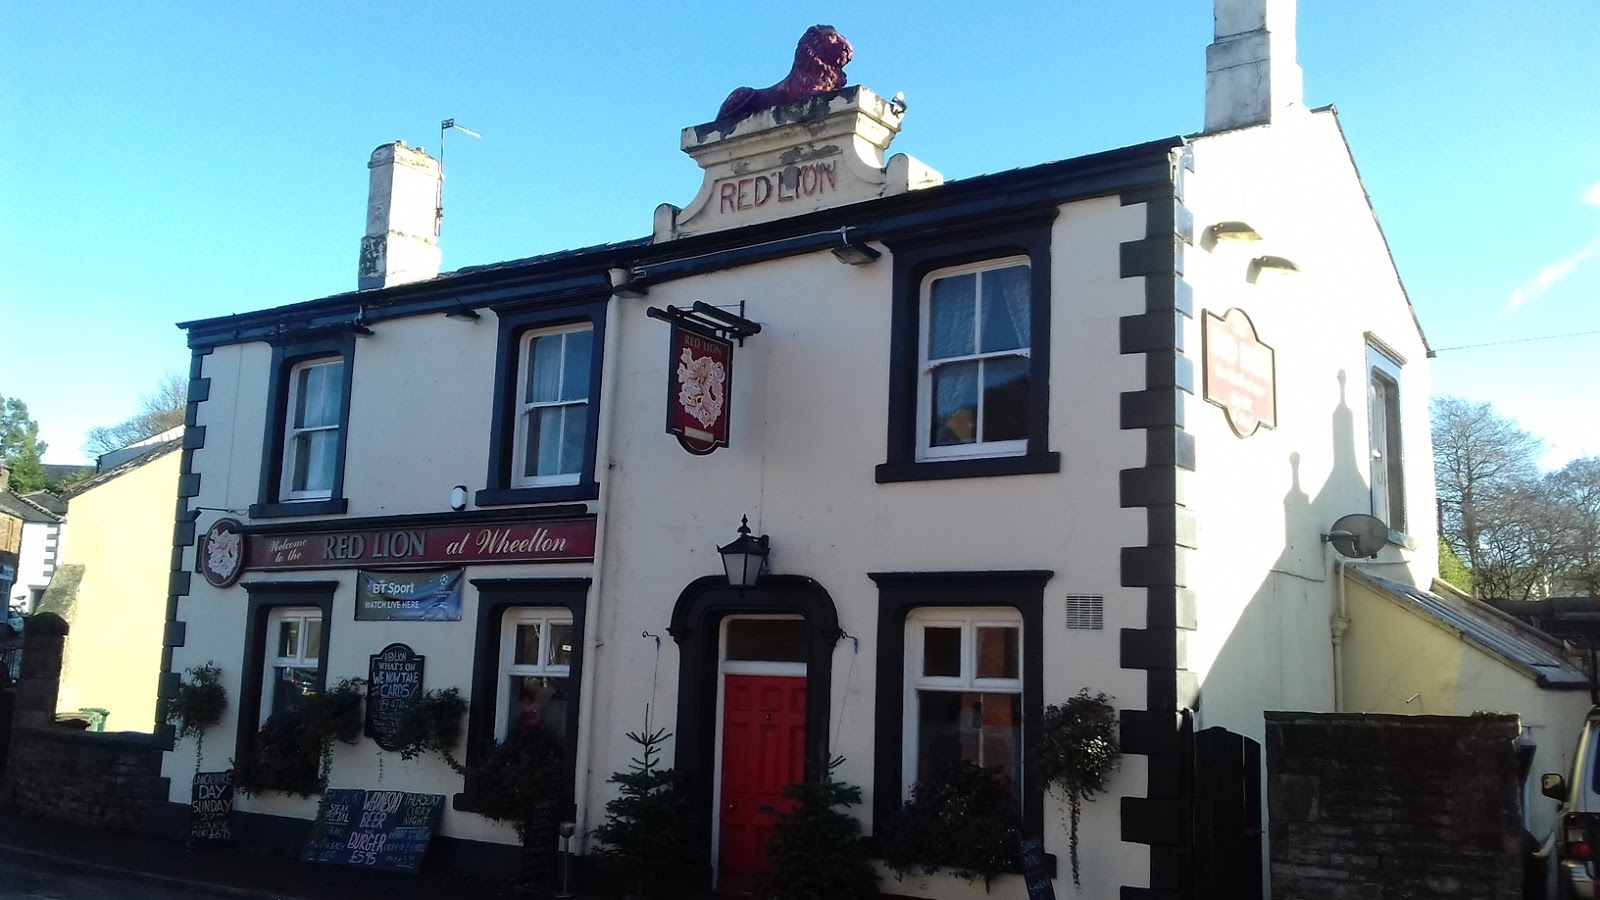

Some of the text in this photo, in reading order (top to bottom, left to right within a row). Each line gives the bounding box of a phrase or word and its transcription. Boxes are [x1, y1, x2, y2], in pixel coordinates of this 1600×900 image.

[720, 160, 838, 214] RED LION
[684, 335, 722, 356] RED LION
[269, 538, 308, 553] Welcome
[322, 531, 427, 560] RED LION
[446, 527, 567, 555] at Wheelton
[274, 549, 302, 563] to the
[372, 582, 415, 595] BT Sport
[365, 600, 420, 609] WATCH LIVE HERE
[378, 662, 416, 671] WHAT'S ON
[372, 671, 419, 684] WE NOW TAKE
[380, 683, 410, 698] CARDS
[198, 784, 227, 799] DAY
[192, 799, 232, 813] SUNDAY
[404, 793, 442, 807] THURSDAY
[328, 803, 350, 814] STEAK
[406, 806, 432, 816] CURRY
[359, 811, 387, 828] BEER
[402, 815, 429, 826] NIGHT
[346, 831, 388, 853] BURGER
